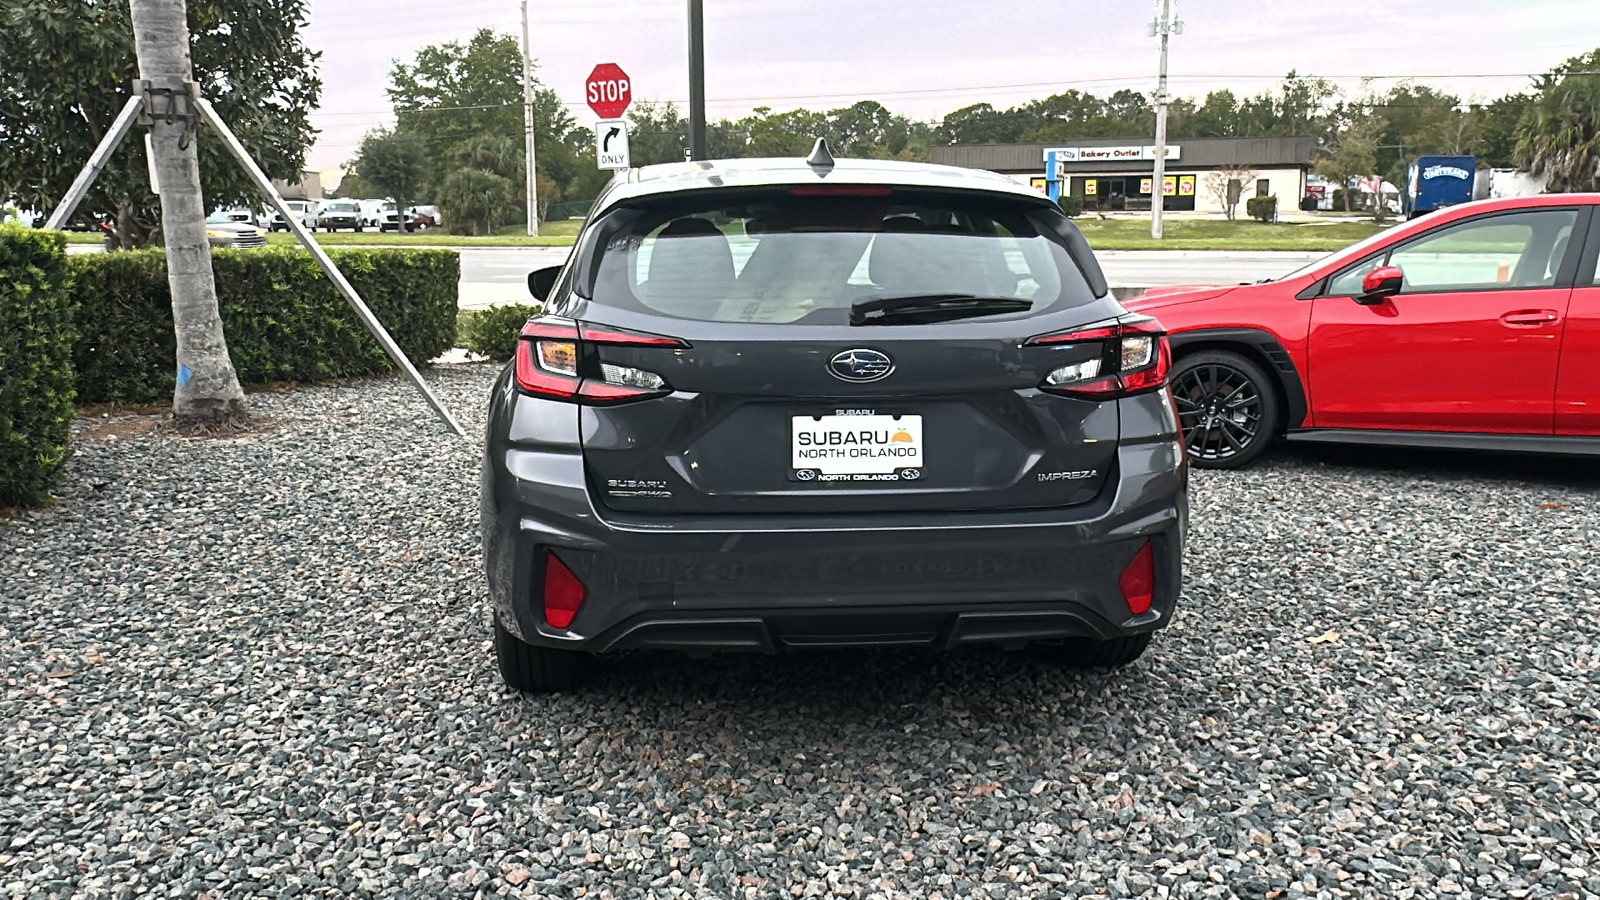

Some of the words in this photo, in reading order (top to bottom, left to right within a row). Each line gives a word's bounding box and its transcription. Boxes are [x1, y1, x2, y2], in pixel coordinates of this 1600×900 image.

[588, 80, 628, 103] STOP
[601, 154, 624, 164] ONLY
[798, 430, 888, 446] SUBARU
[798, 448, 845, 458] NORTH
[849, 447, 917, 458] ORLANDO
[1038, 469, 1097, 481] IMPREZA
[608, 479, 667, 488] SUBARU
